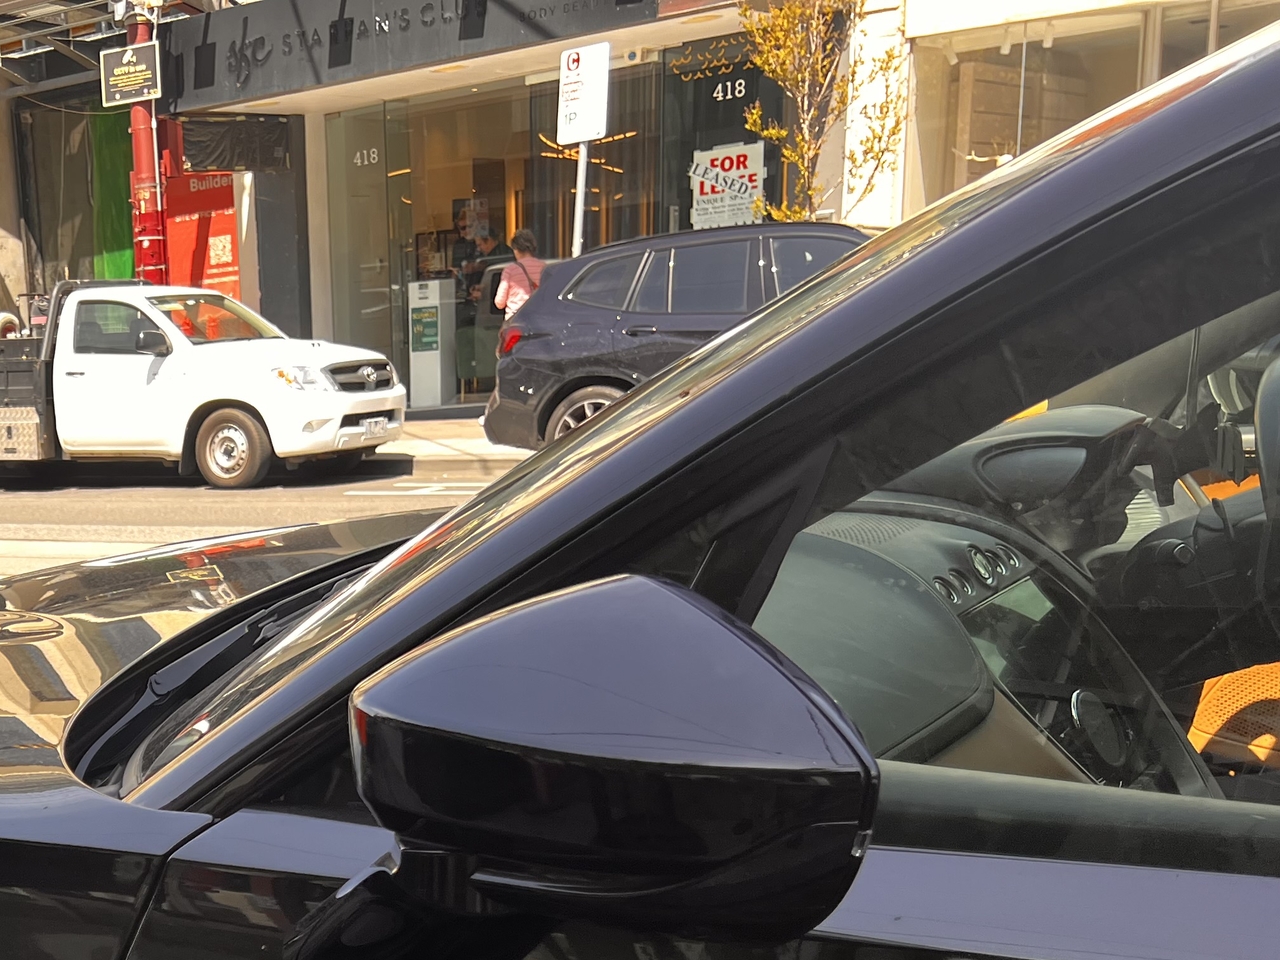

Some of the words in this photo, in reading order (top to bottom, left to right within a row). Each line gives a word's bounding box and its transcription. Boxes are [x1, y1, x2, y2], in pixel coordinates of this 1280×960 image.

[712, 79, 746, 102] 418
[353, 148, 379, 167] 418
[709, 153, 749, 173] FOR
[692, 162, 749, 196] LEASED
[696, 196, 726, 207] UNIQUE
